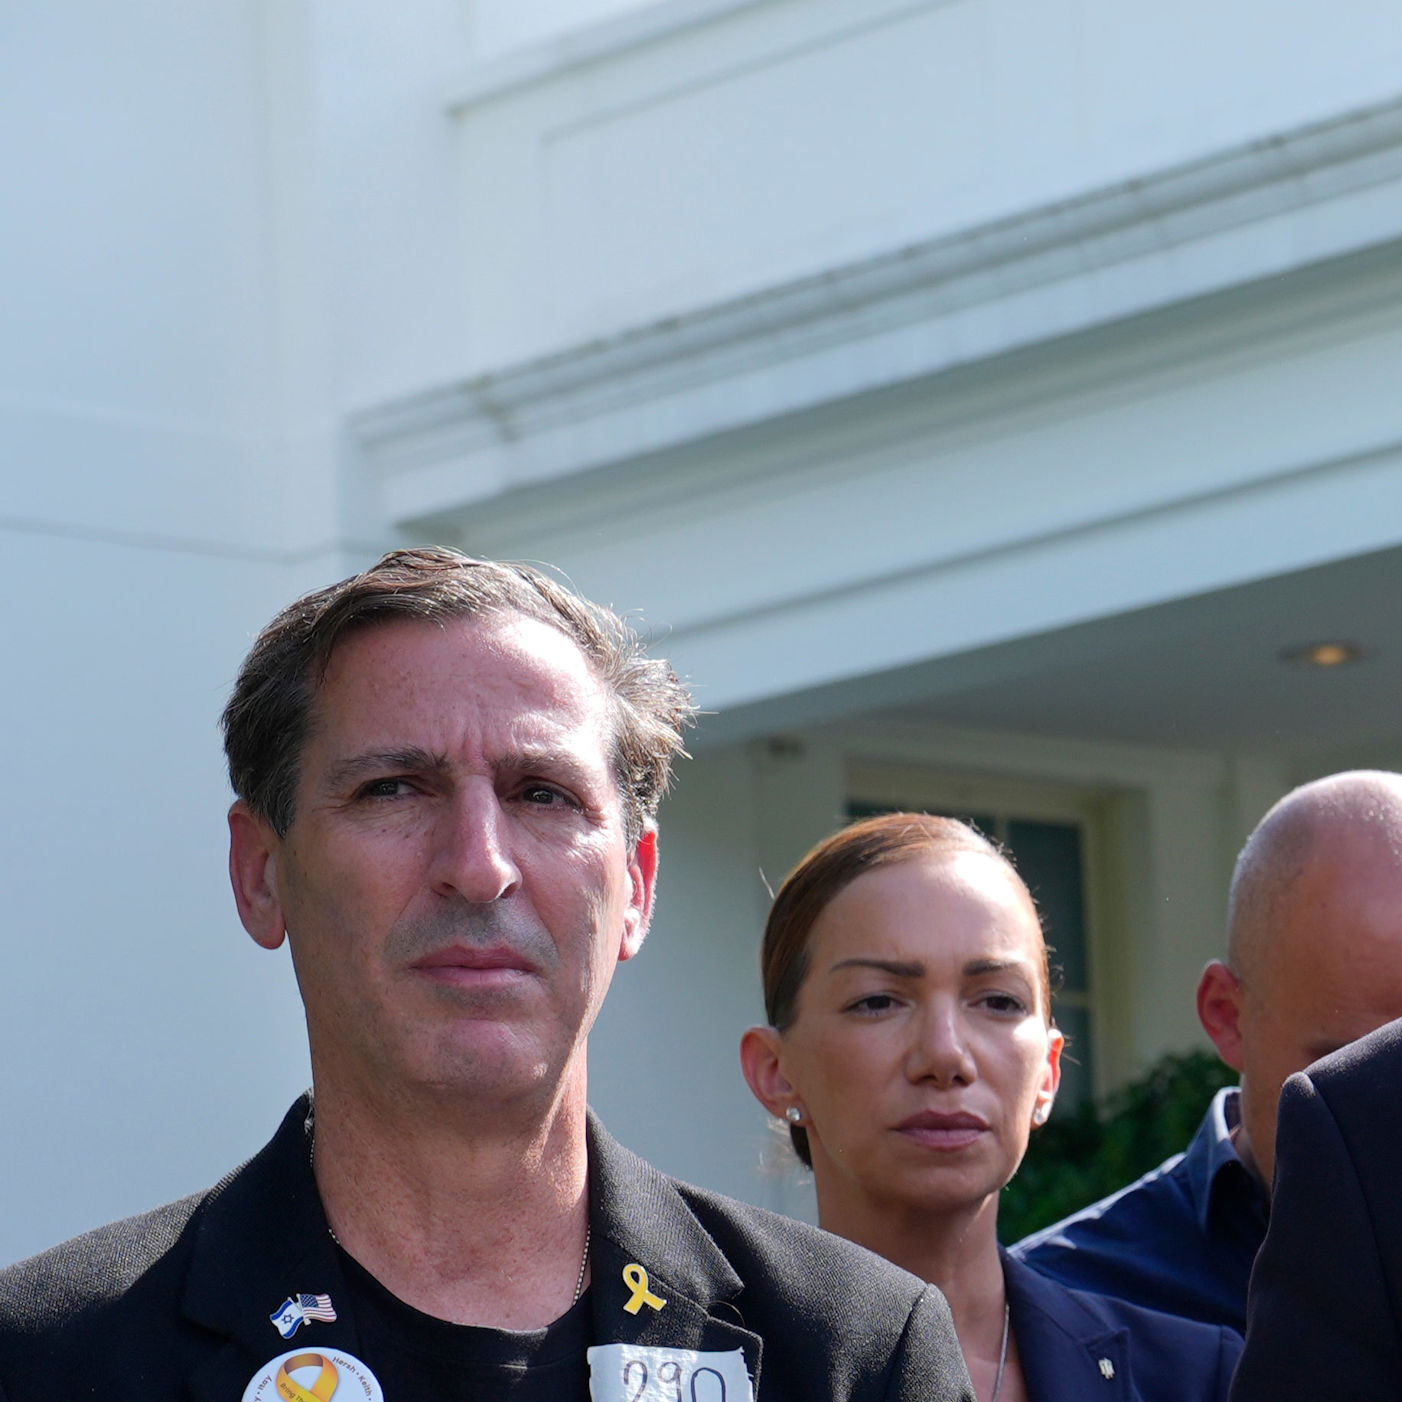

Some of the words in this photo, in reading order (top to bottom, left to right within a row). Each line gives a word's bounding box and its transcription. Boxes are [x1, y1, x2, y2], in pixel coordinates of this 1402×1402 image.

[332, 1356, 356, 1373] Hersh
[258, 1375, 272, 1391] Itay
[280, 1382, 296, 1399] Bring
[358, 1375, 373, 1397] Keith
